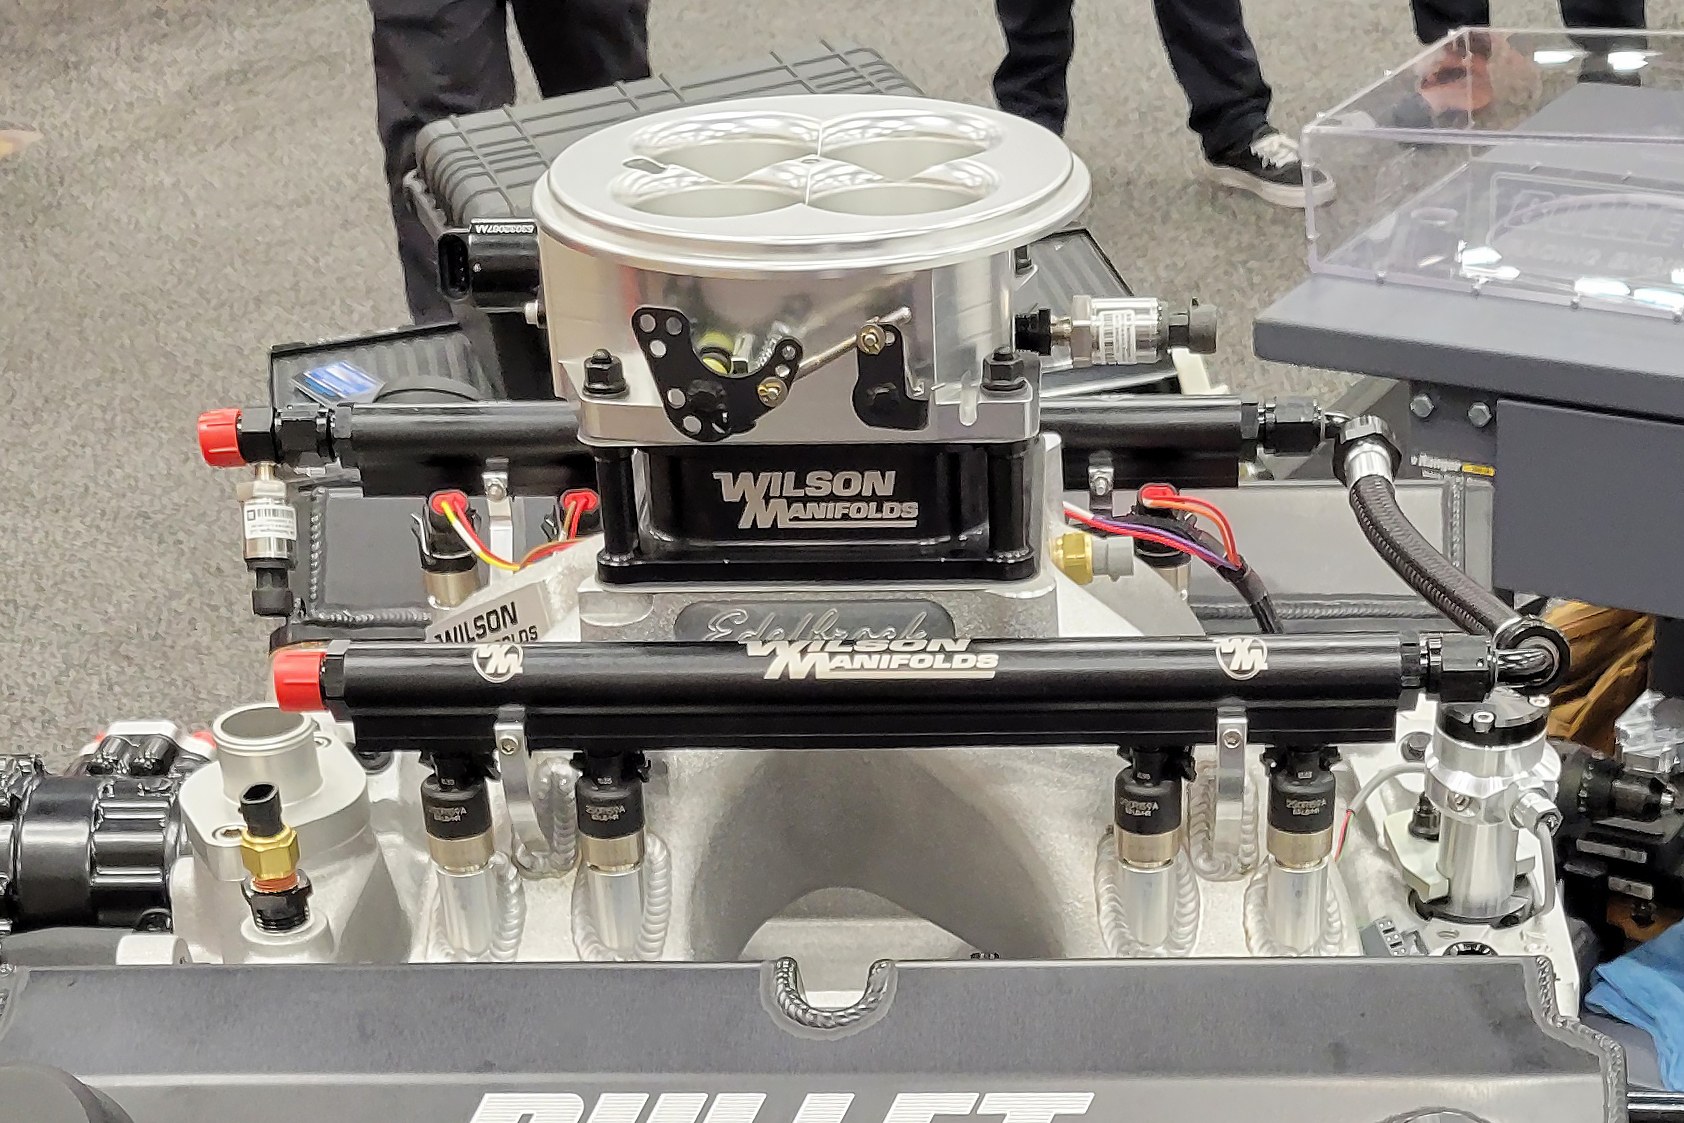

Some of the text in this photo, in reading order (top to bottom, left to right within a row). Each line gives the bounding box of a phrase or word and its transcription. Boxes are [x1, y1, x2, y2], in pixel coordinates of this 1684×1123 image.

[712, 470, 896, 502] WILSON
[738, 498, 919, 530] MANIFOLDS
[738, 638, 972, 657] WILSON
[763, 652, 999, 680] MANIFOLDS
